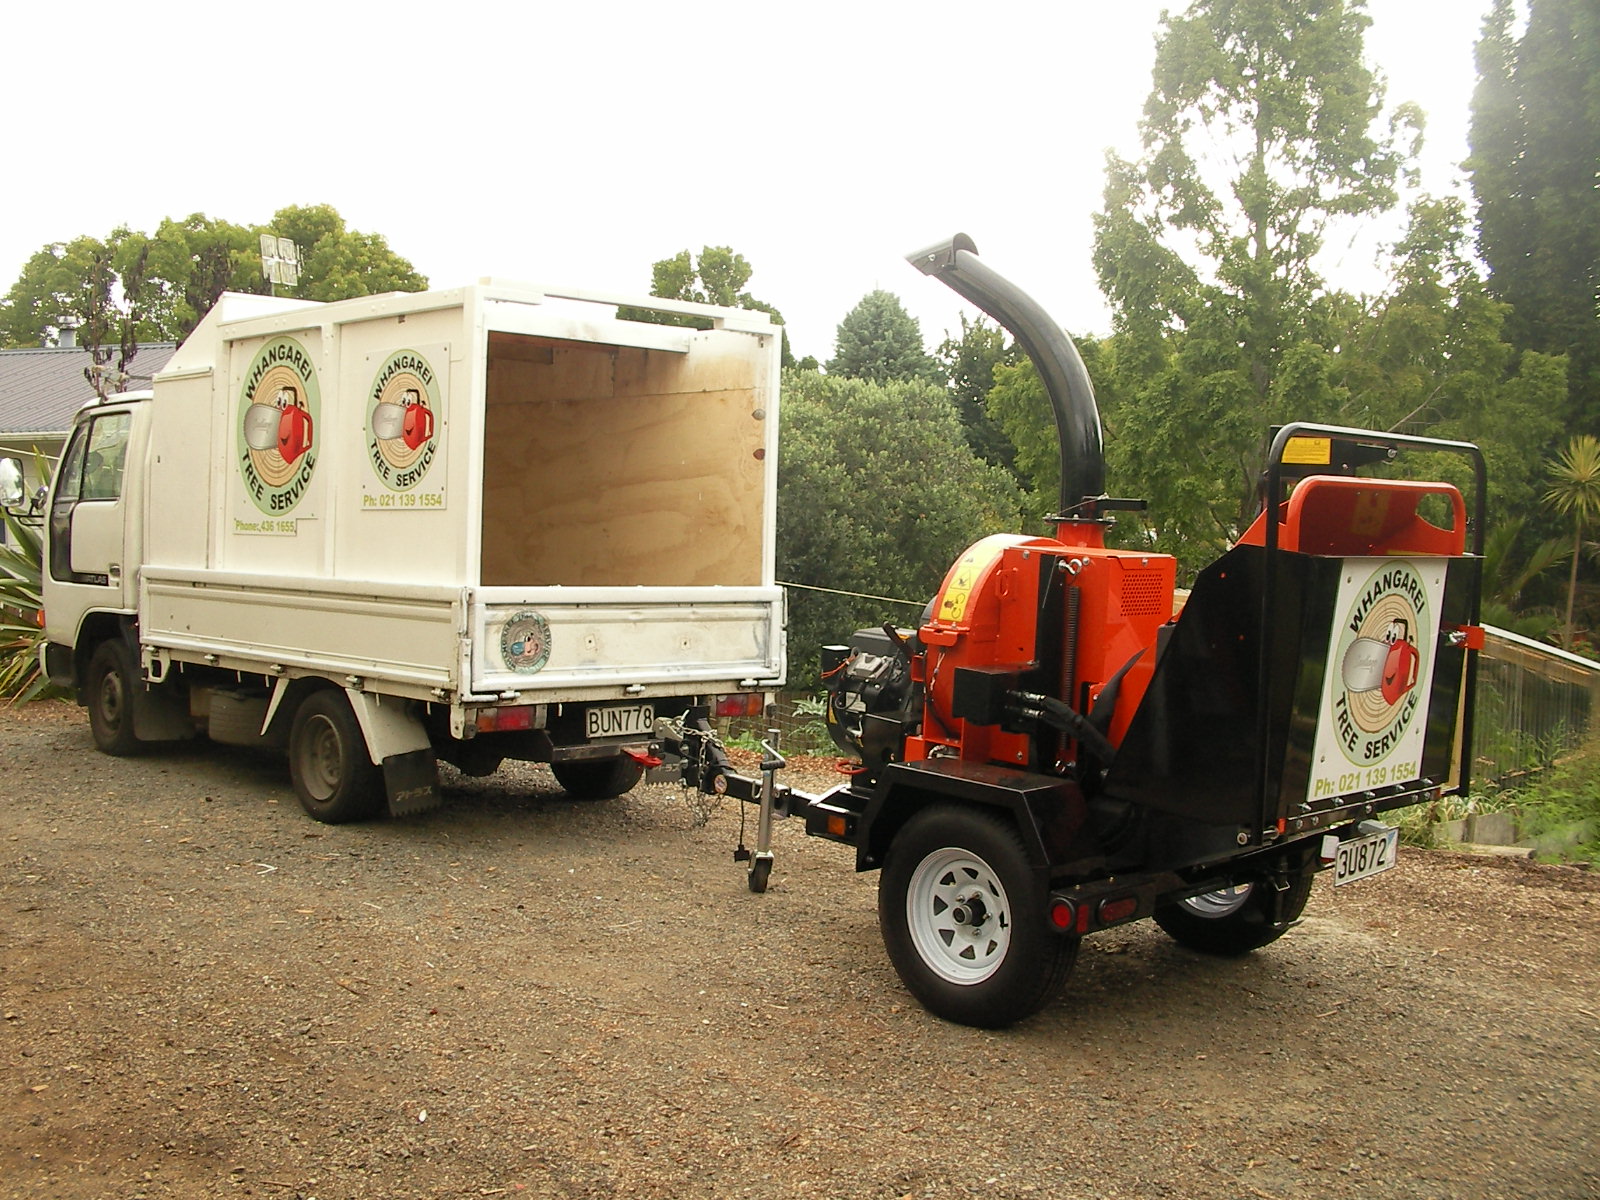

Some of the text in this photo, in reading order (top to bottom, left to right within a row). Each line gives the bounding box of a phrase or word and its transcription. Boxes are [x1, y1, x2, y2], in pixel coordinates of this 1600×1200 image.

[246, 344, 312, 400] WHANGAREI
[373, 356, 432, 400] WHANGAREI
[242, 447, 315, 510] TREE SERVICE
[370, 438, 435, 487] TREE SERVICE
[363, 493, 442, 506] Ph: 021 139 1554
[260, 520, 275, 532] 436
[1350, 569, 1425, 633] WHANGAREI
[589, 707, 652, 734] BUN778
[1335, 691, 1418, 760] TREE SERVICE
[1314, 760, 1417, 797] Ph: 021 139 1554
[1337, 837, 1387, 879] 3U872
